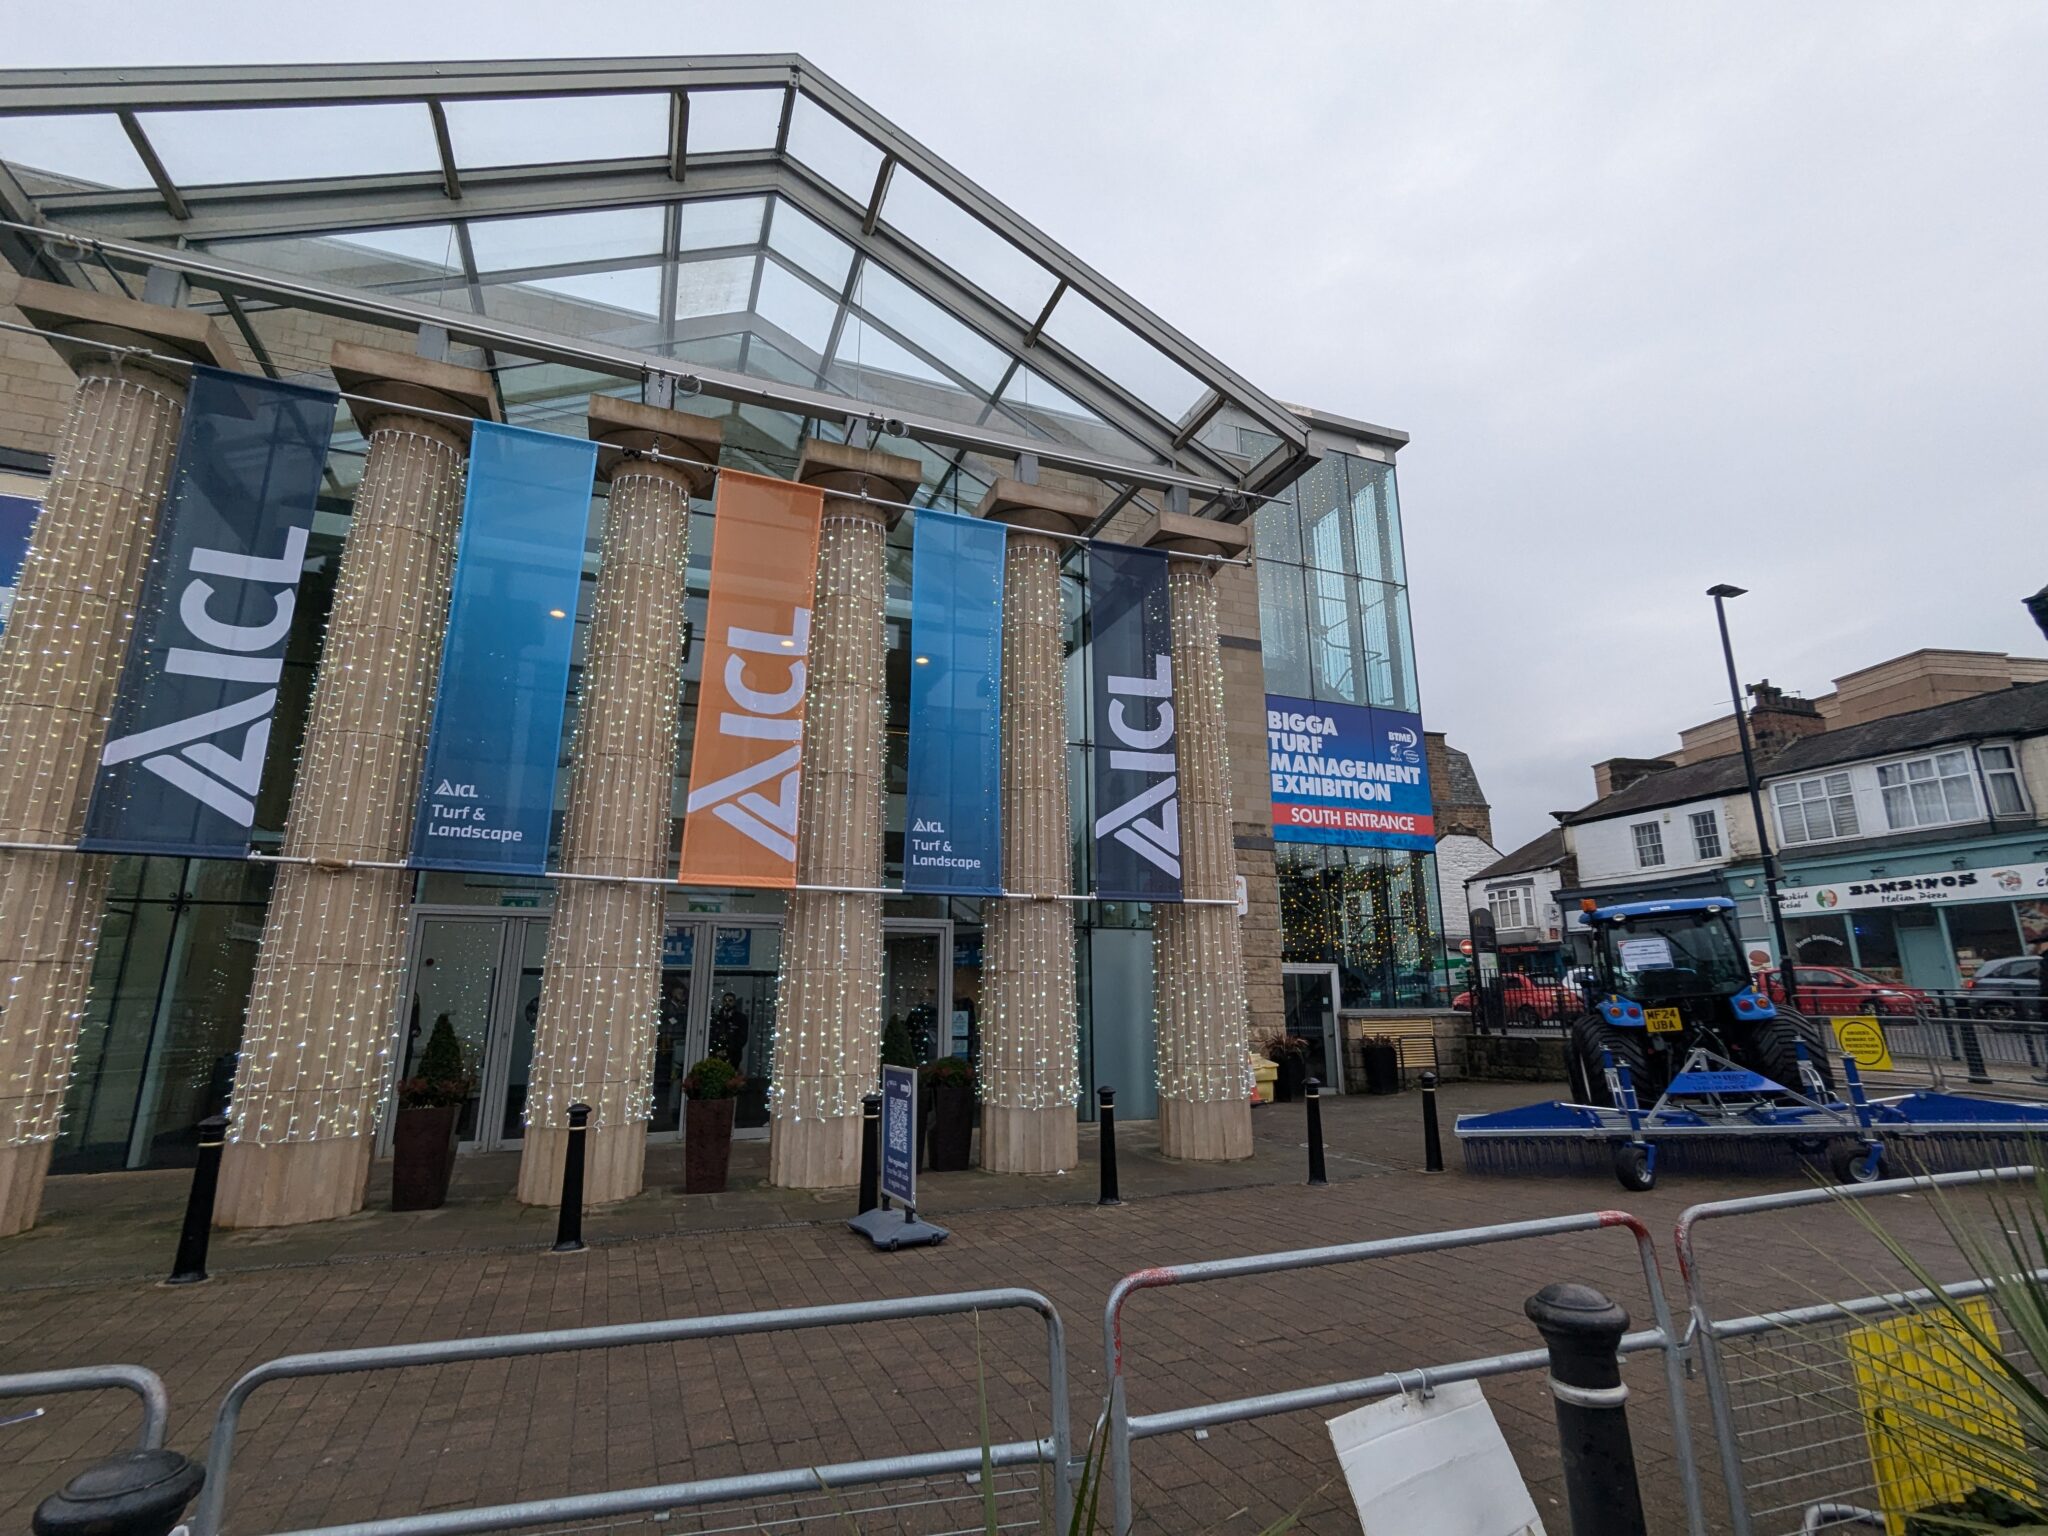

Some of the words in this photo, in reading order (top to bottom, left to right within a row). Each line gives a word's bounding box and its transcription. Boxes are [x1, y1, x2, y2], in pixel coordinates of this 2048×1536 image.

[1267, 711, 1338, 737] BIGGA
[1268, 731, 1323, 755] TURF
[1271, 753, 1420, 785] MANAGEMENT
[1272, 774, 1392, 802] EXHIBITION
[432, 804, 470, 819] Turf
[472, 807, 486, 821] &
[1291, 807, 1341, 826] SOUTH
[1345, 811, 1415, 831] ENTRANCE
[428, 822, 523, 843] Landscape
[912, 839, 941, 852] Turf
[942, 841, 952, 852] &
[912, 854, 981, 870] Landscape
